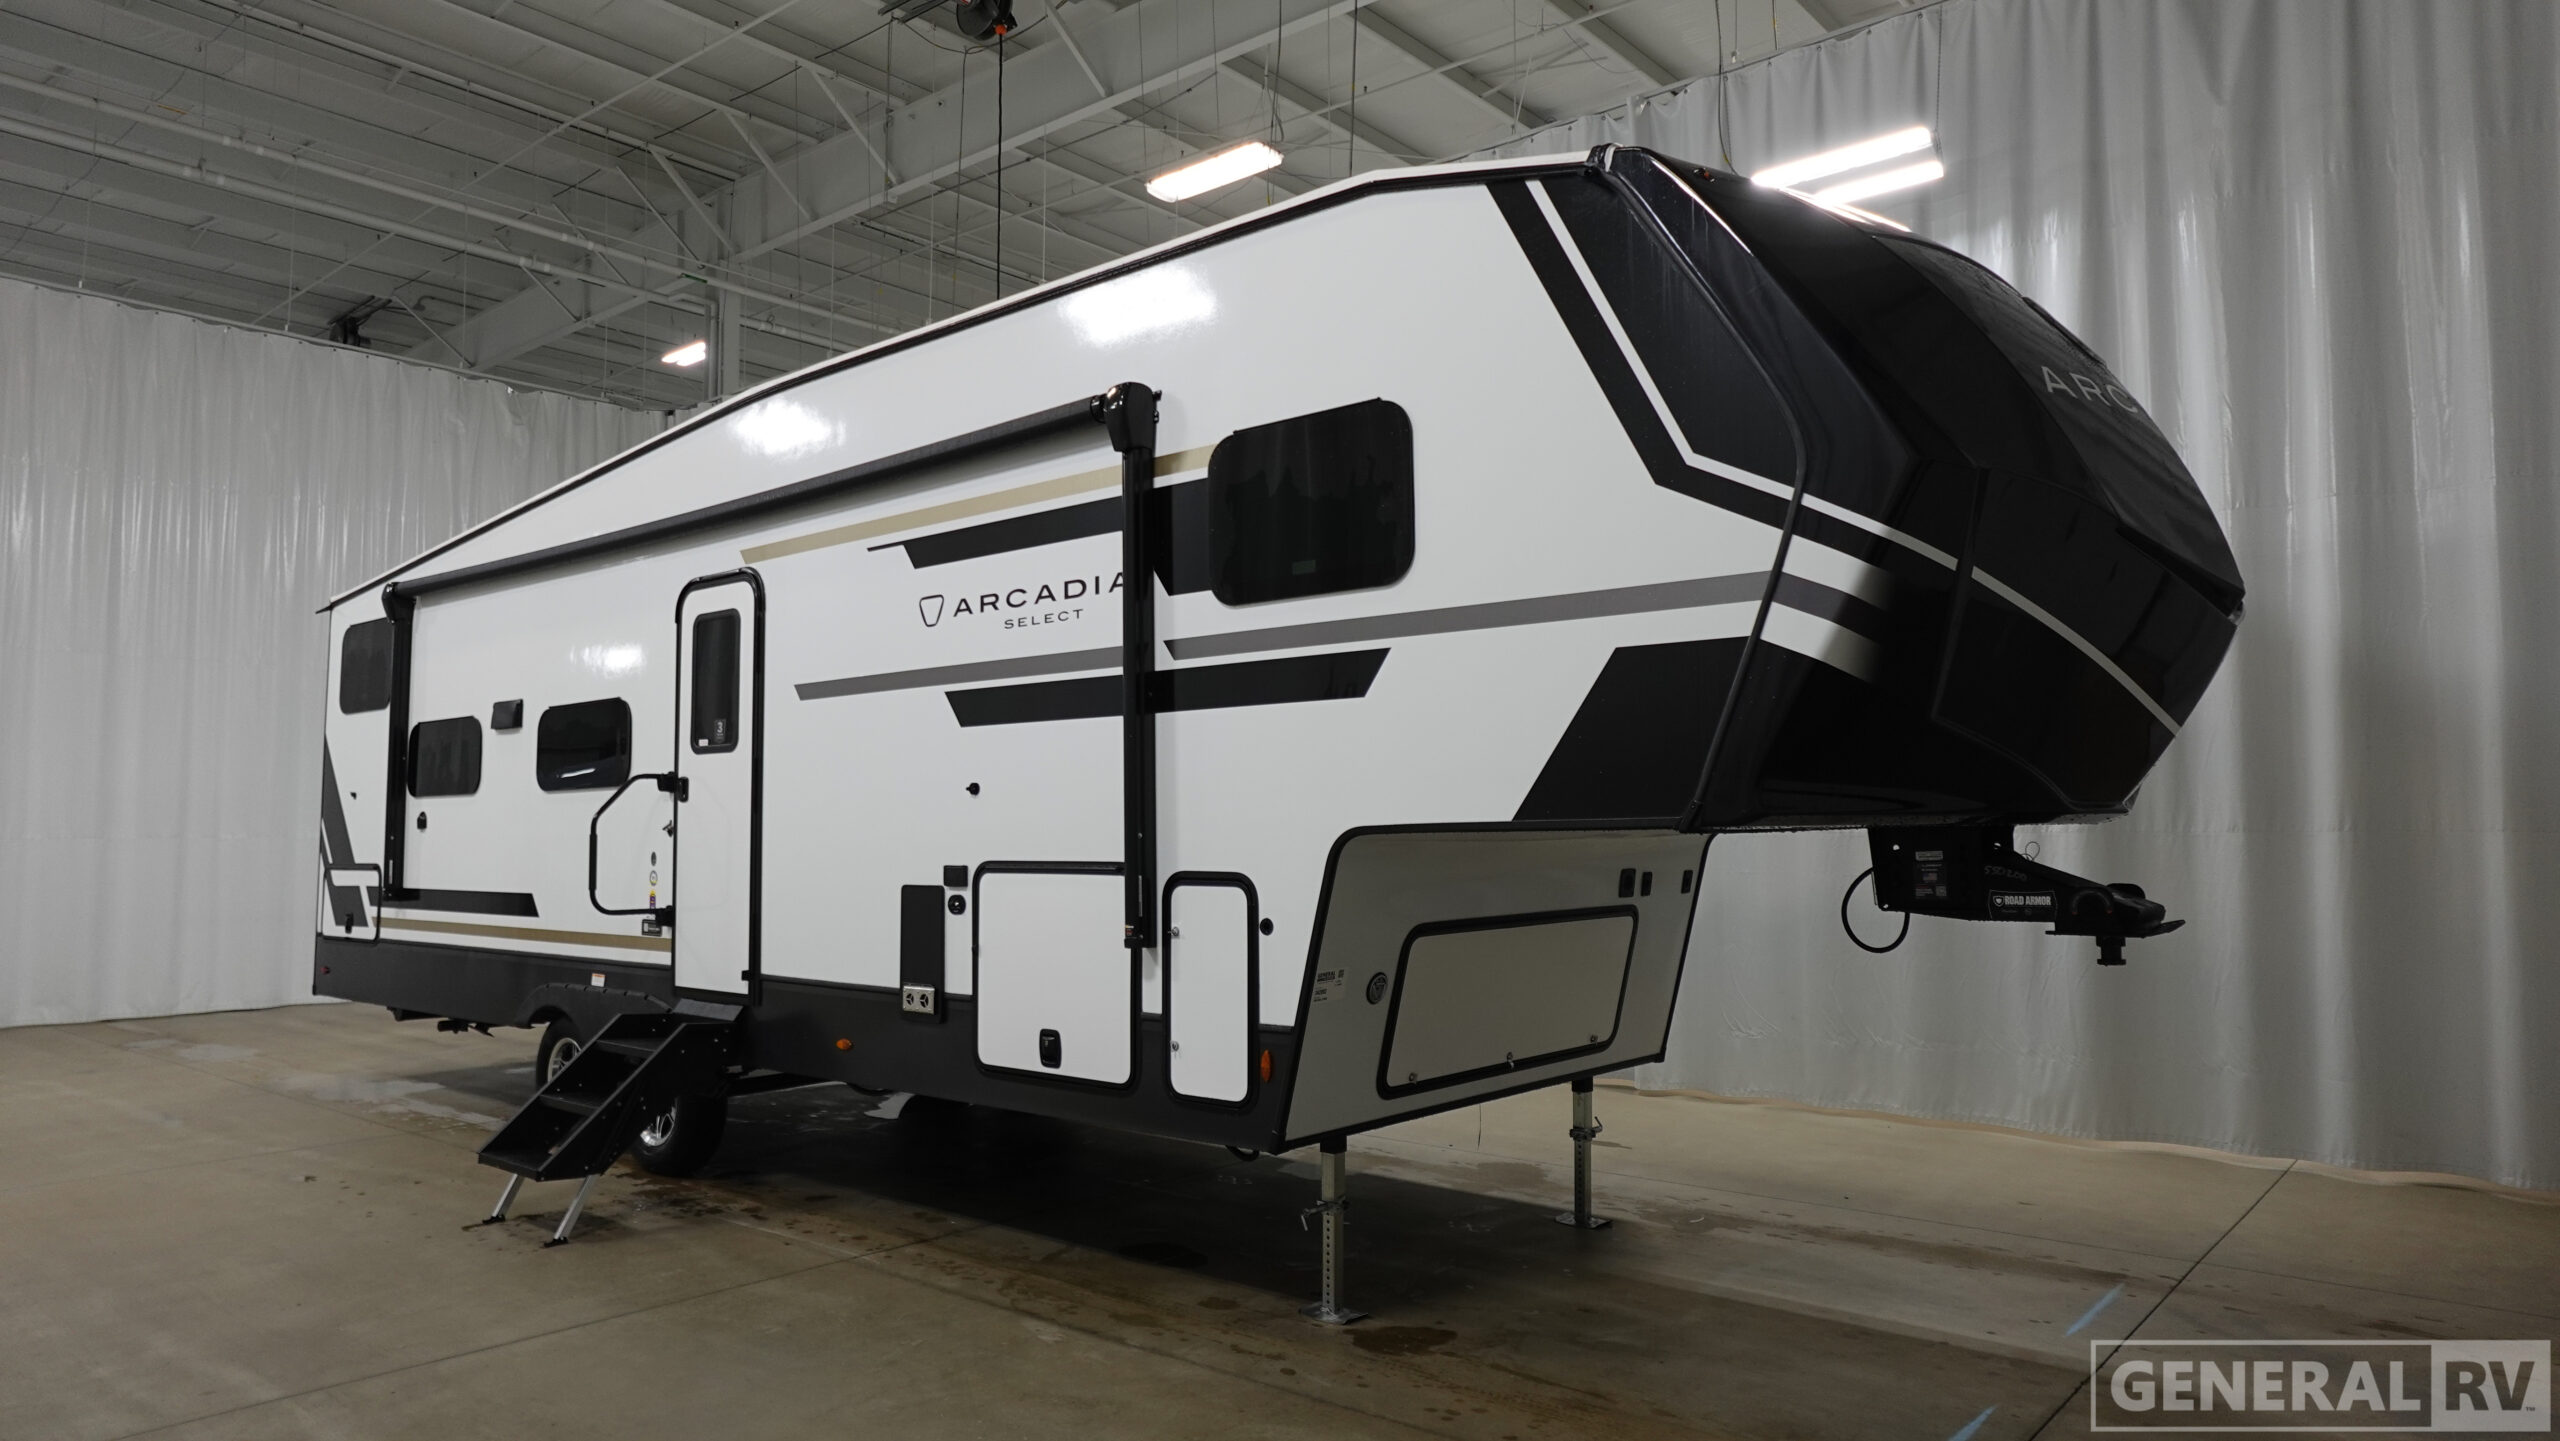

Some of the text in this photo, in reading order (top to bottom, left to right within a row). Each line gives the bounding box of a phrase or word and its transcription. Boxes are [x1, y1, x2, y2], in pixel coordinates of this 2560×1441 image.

[1004, 608, 1084, 629] SELECT
[2004, 895, 2051, 905] ROAD ARMOR
